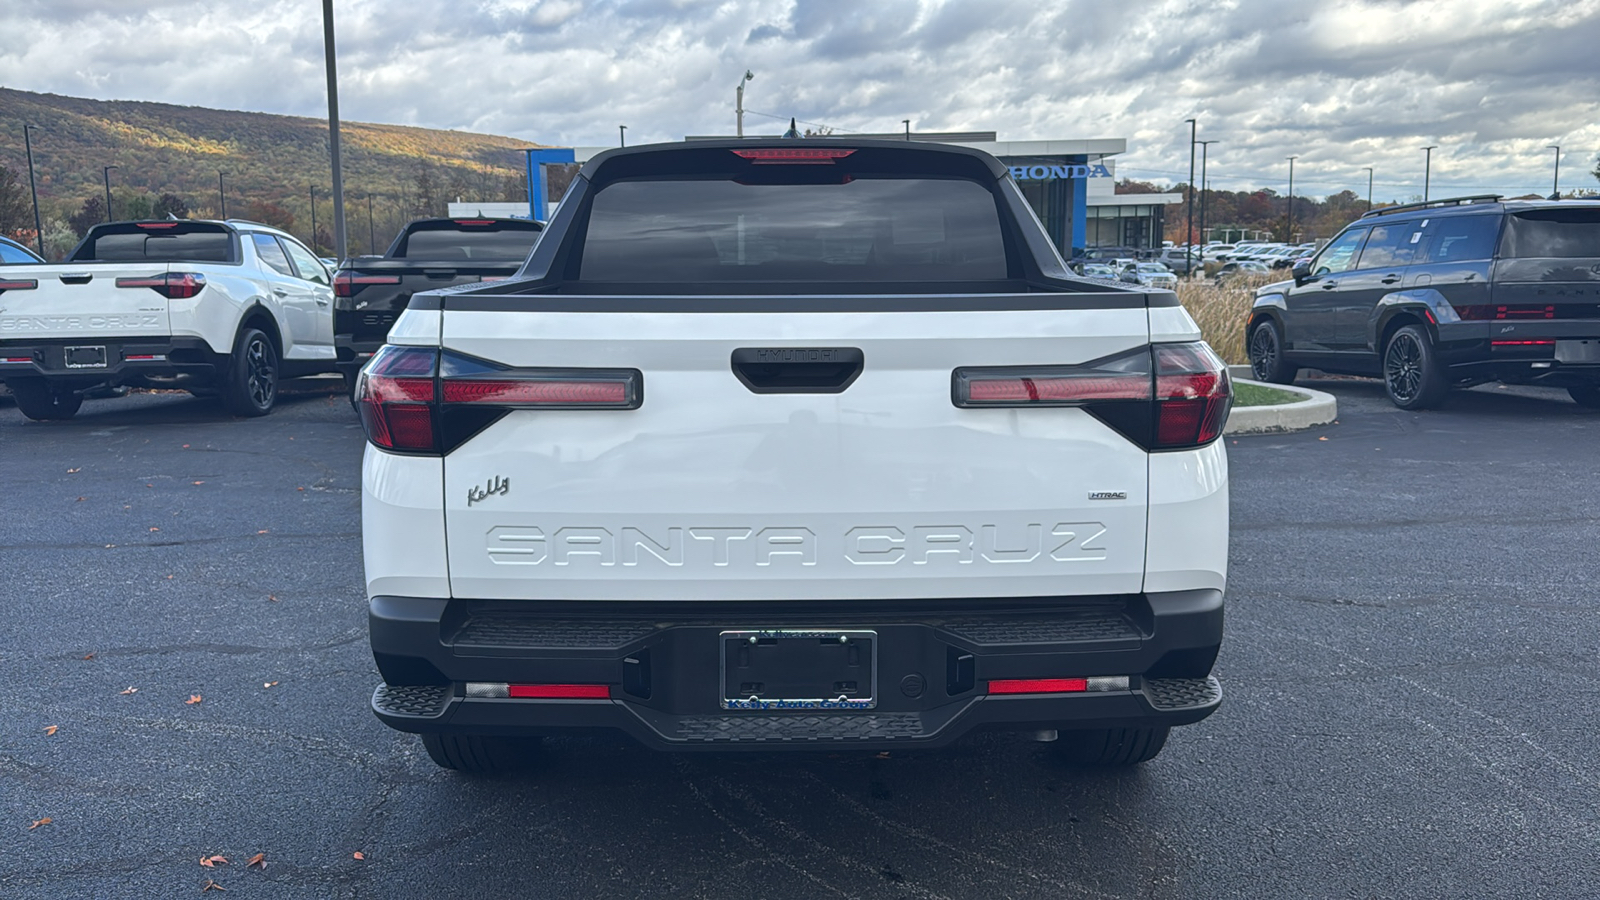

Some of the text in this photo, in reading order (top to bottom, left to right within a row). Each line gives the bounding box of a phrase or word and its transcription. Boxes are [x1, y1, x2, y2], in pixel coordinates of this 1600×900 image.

[1008, 165, 1112, 180] HONDA
[1, 317, 83, 330] SANTA
[757, 349, 839, 361] HYUNDAI
[467, 475, 510, 507] Kelly
[1090, 491, 1125, 499] HTRAC
[486, 521, 1107, 567] SANTA CRUZ
[728, 699, 869, 709] Kelly Auto Group
